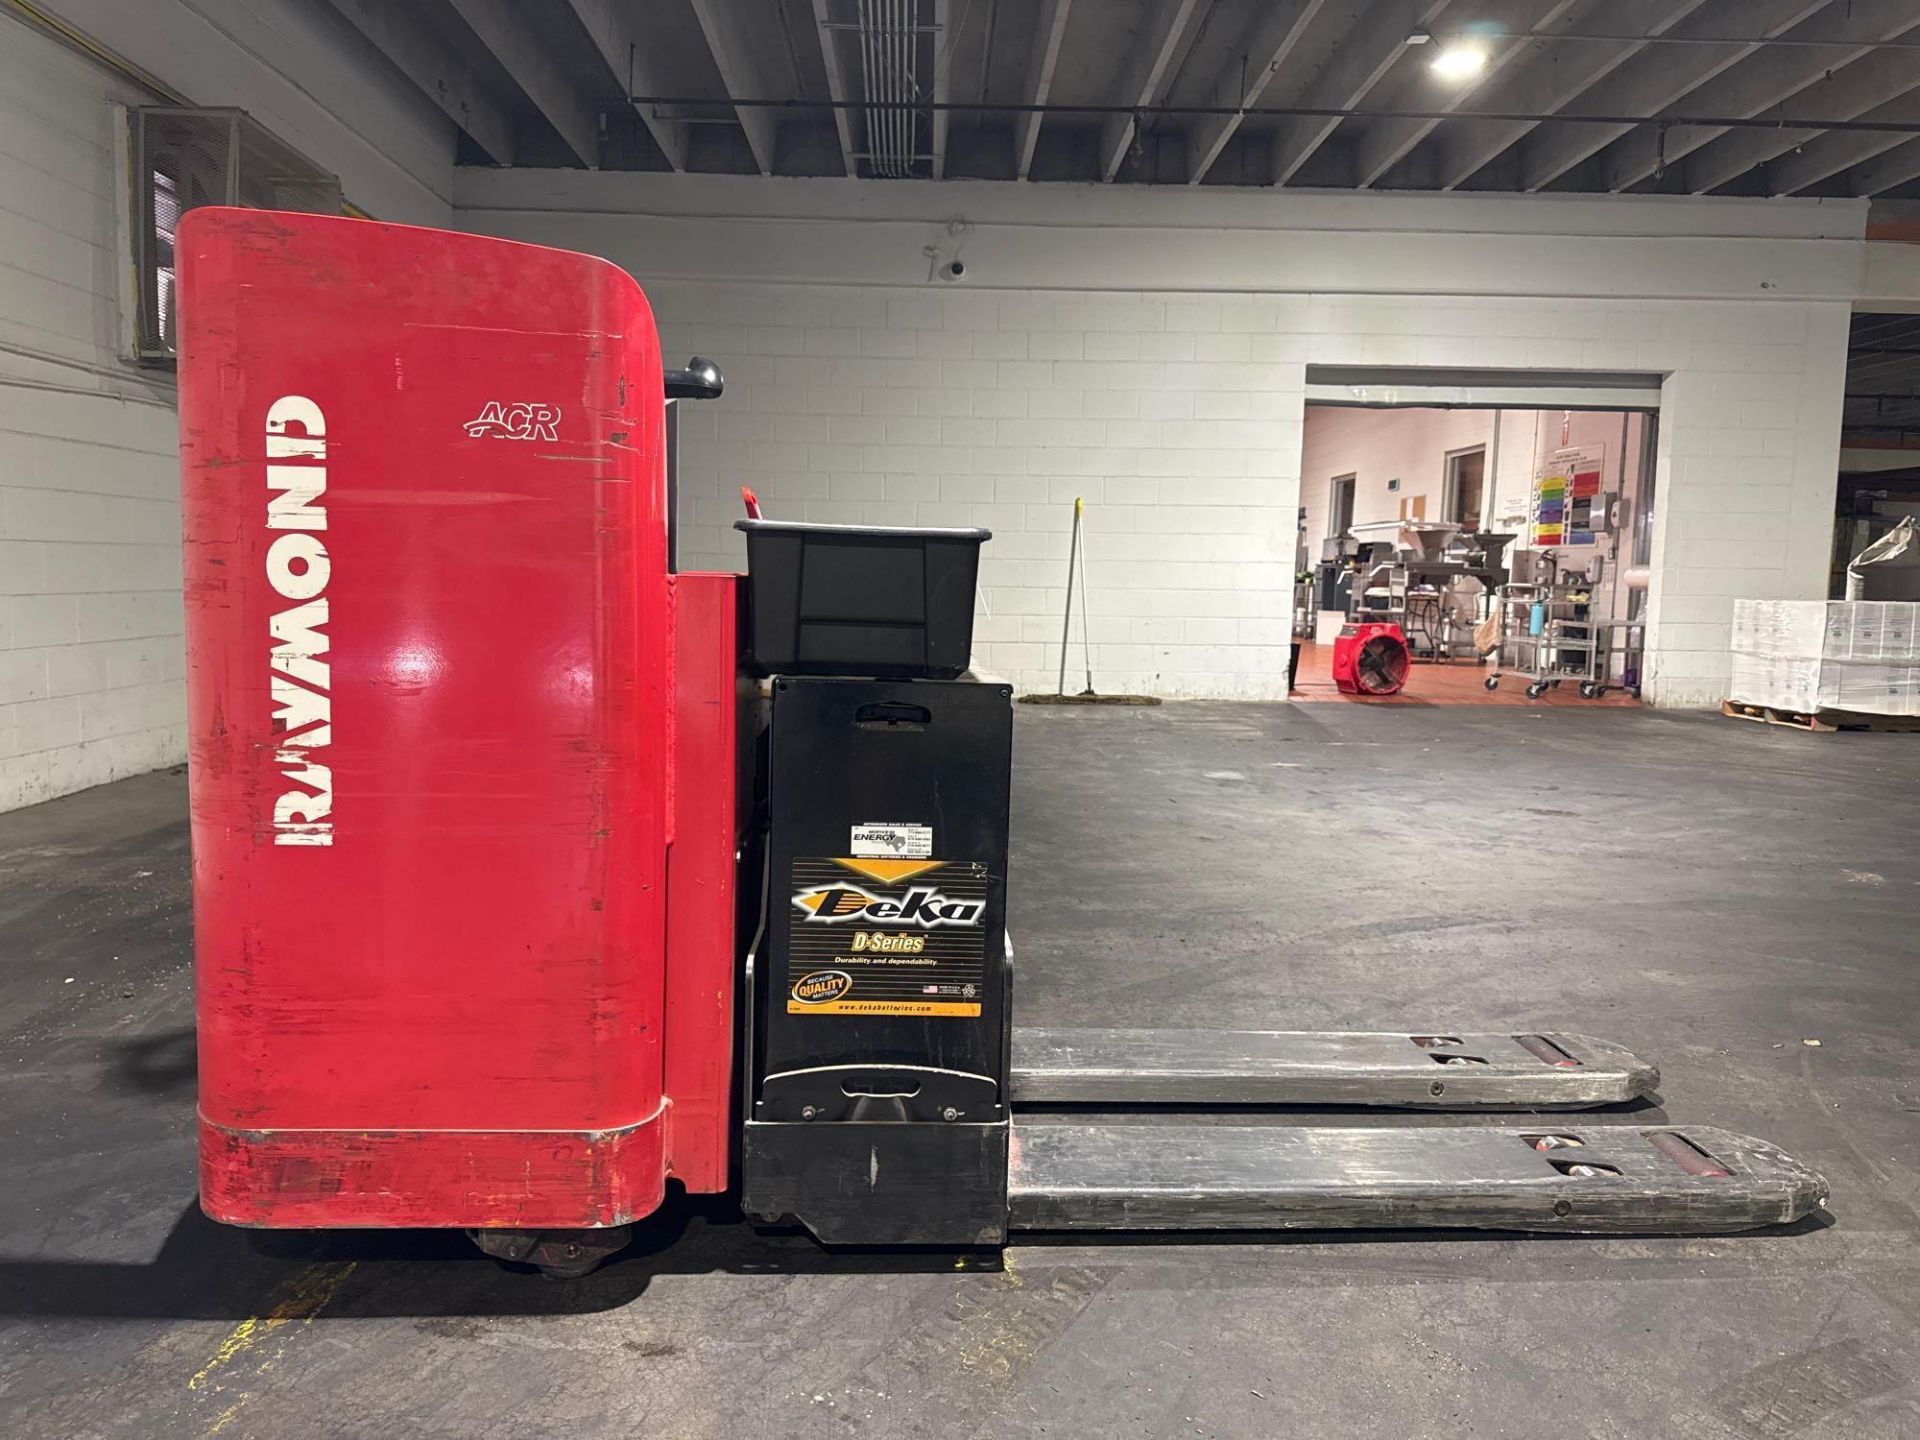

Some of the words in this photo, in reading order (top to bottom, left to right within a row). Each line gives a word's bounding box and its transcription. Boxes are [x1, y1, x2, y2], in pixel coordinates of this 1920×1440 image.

[463, 401, 561, 441] ACR
[265, 394, 333, 847] RAYMOND
[853, 833, 896, 841] ENERGY
[804, 885, 986, 926] Deka
[851, 932, 925, 953] D-Series
[834, 956, 871, 965] Durability
[888, 957, 937, 966] dependability
[799, 977, 844, 997] QUALITY
[806, 974, 834, 985] BECAUSE
[812, 989, 839, 999] MATTERS
[838, 1004, 932, 1012] www.dekabatteries.com
